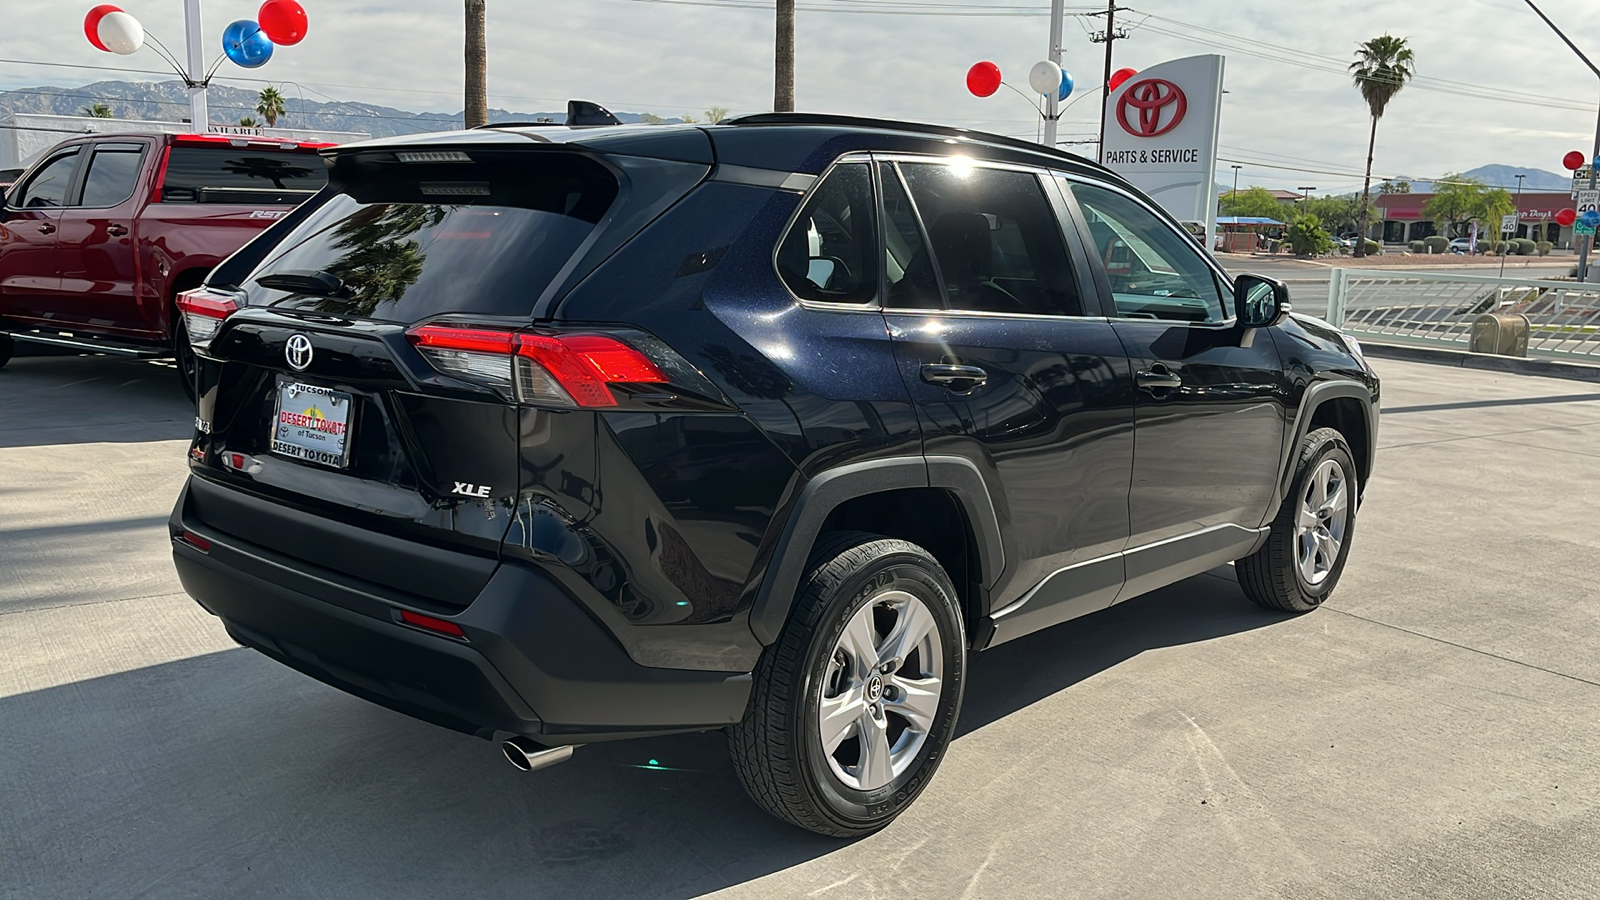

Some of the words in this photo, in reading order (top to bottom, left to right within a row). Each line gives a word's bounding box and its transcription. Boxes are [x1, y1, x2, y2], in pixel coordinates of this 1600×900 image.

[208, 126, 262, 136] VAILABLE
[1106, 150, 1137, 164] PARTS
[1139, 150, 1148, 163] &
[1151, 149, 1198, 163] SERVICE
[1578, 203, 1596, 213] 40
[249, 210, 288, 219] RST
[295, 384, 332, 396] TUCSON
[281, 411, 313, 429] DESERT
[315, 417, 347, 435] TOYOTA
[305, 430, 326, 441] Tucson
[273, 441, 301, 456] DESERT
[304, 449, 339, 466] TOYOTA
[451, 481, 491, 498] XLE
